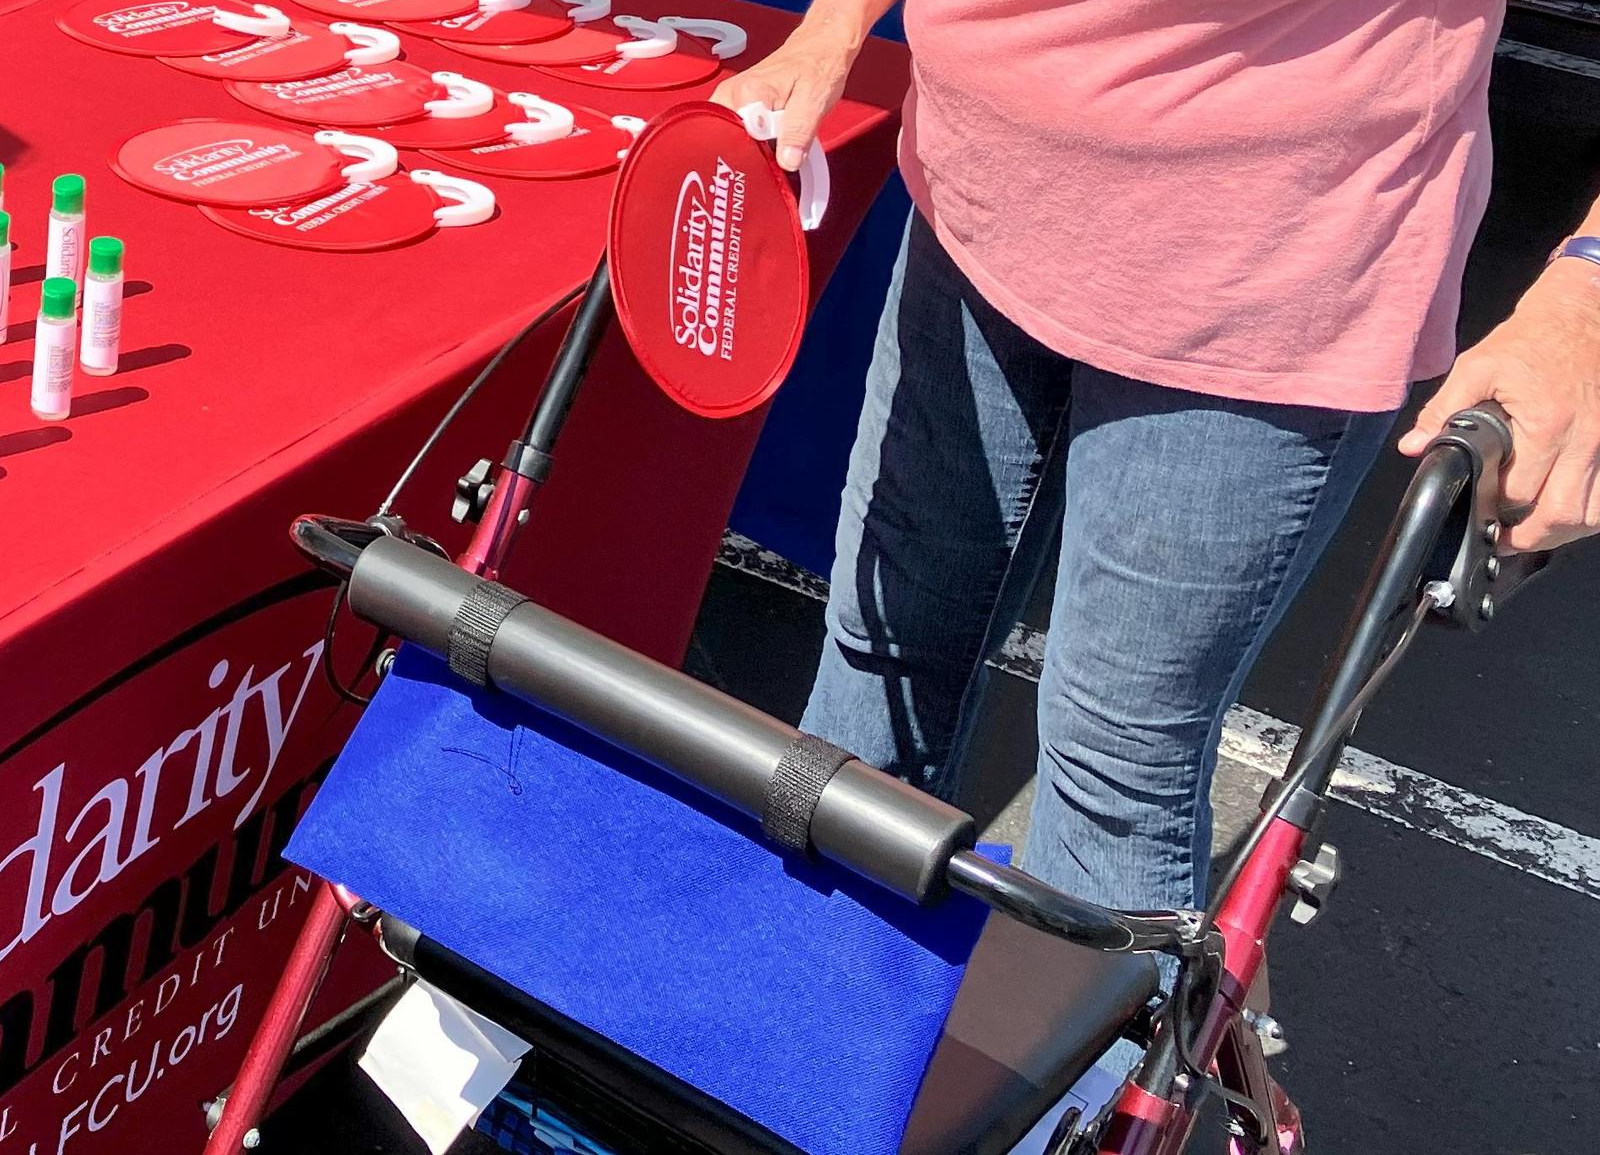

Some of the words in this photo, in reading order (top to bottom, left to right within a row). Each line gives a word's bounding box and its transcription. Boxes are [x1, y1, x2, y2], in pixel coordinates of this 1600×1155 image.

[173, 143, 291, 181] Community
[731, 170, 747, 223] UNION
[675, 195, 712, 348] Solidarity
[698, 156, 736, 357] Community
[727, 224, 743, 282] CREDIT
[720, 284, 738, 361] FEDERAL
[53, 927, 234, 1094] CREDIT
